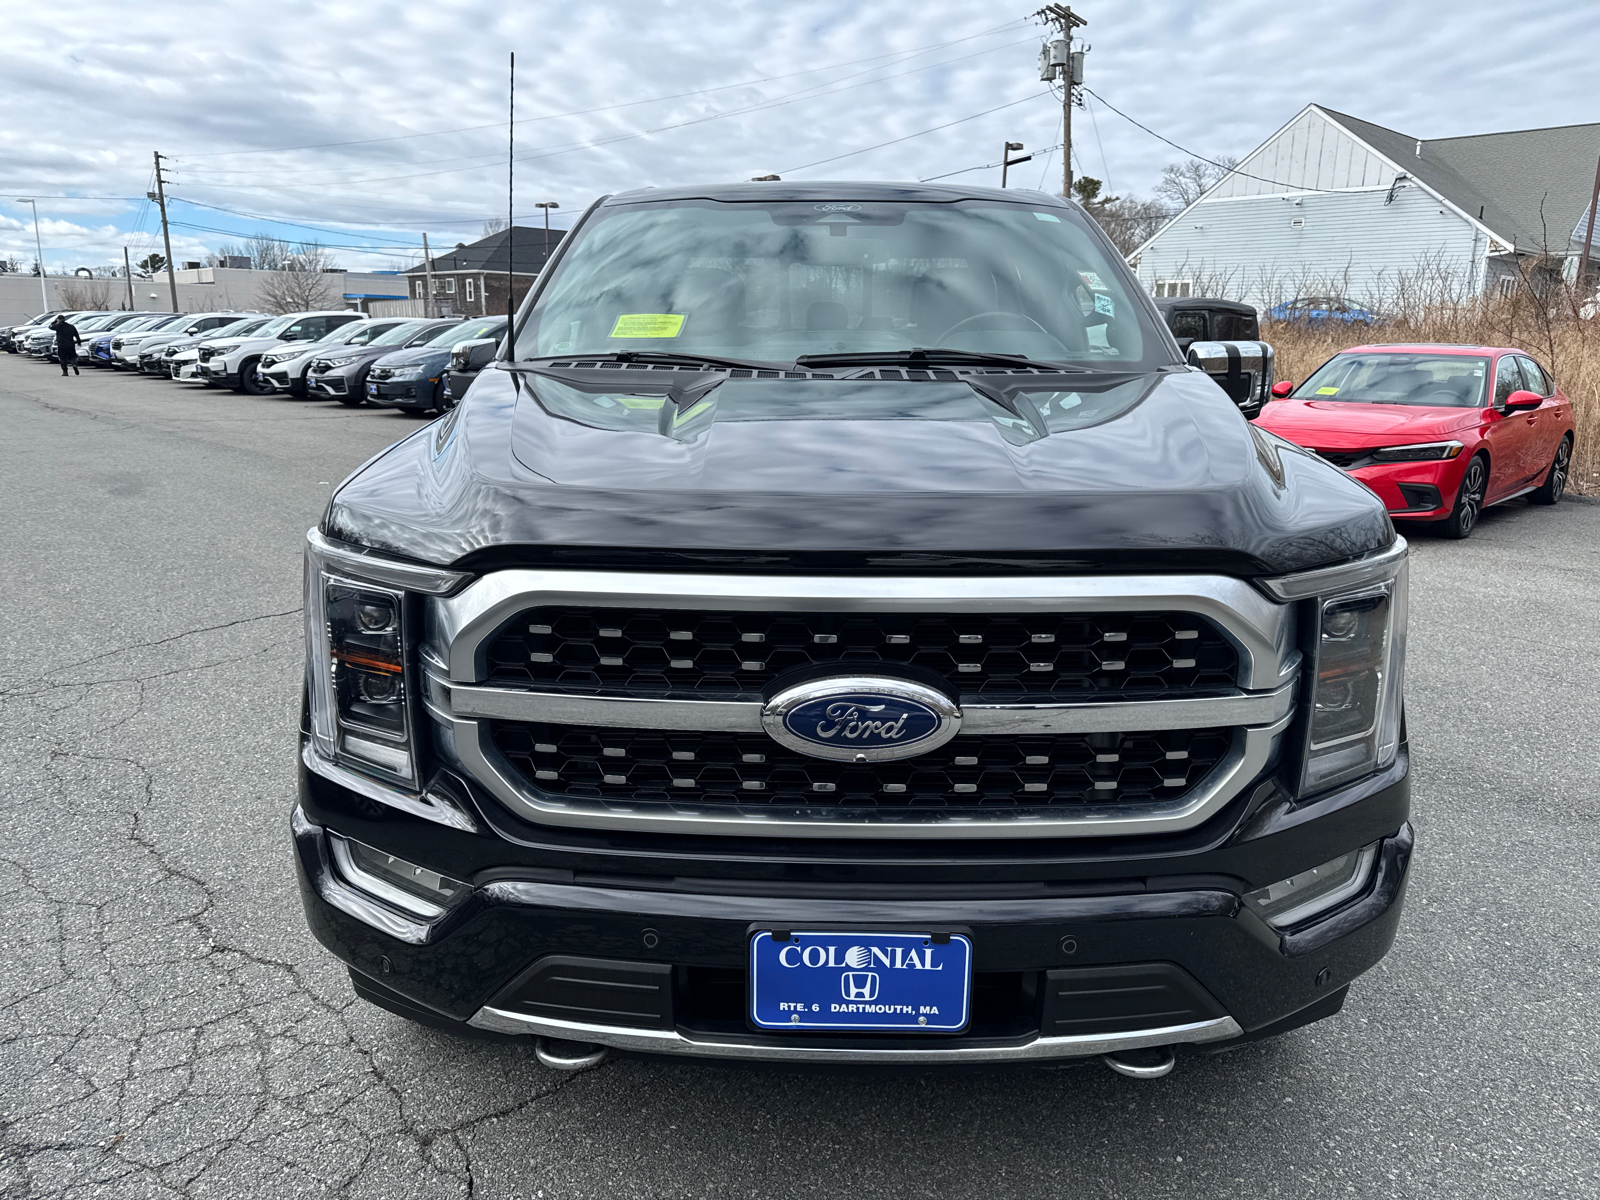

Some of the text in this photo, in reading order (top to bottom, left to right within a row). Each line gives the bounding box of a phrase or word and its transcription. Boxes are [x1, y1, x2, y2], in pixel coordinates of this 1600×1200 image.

[816, 702, 909, 739] Ford
[778, 945, 943, 970] COLONIAL
[779, 1002, 939, 1015] RTE. 6 DARTMOUTH, MA
